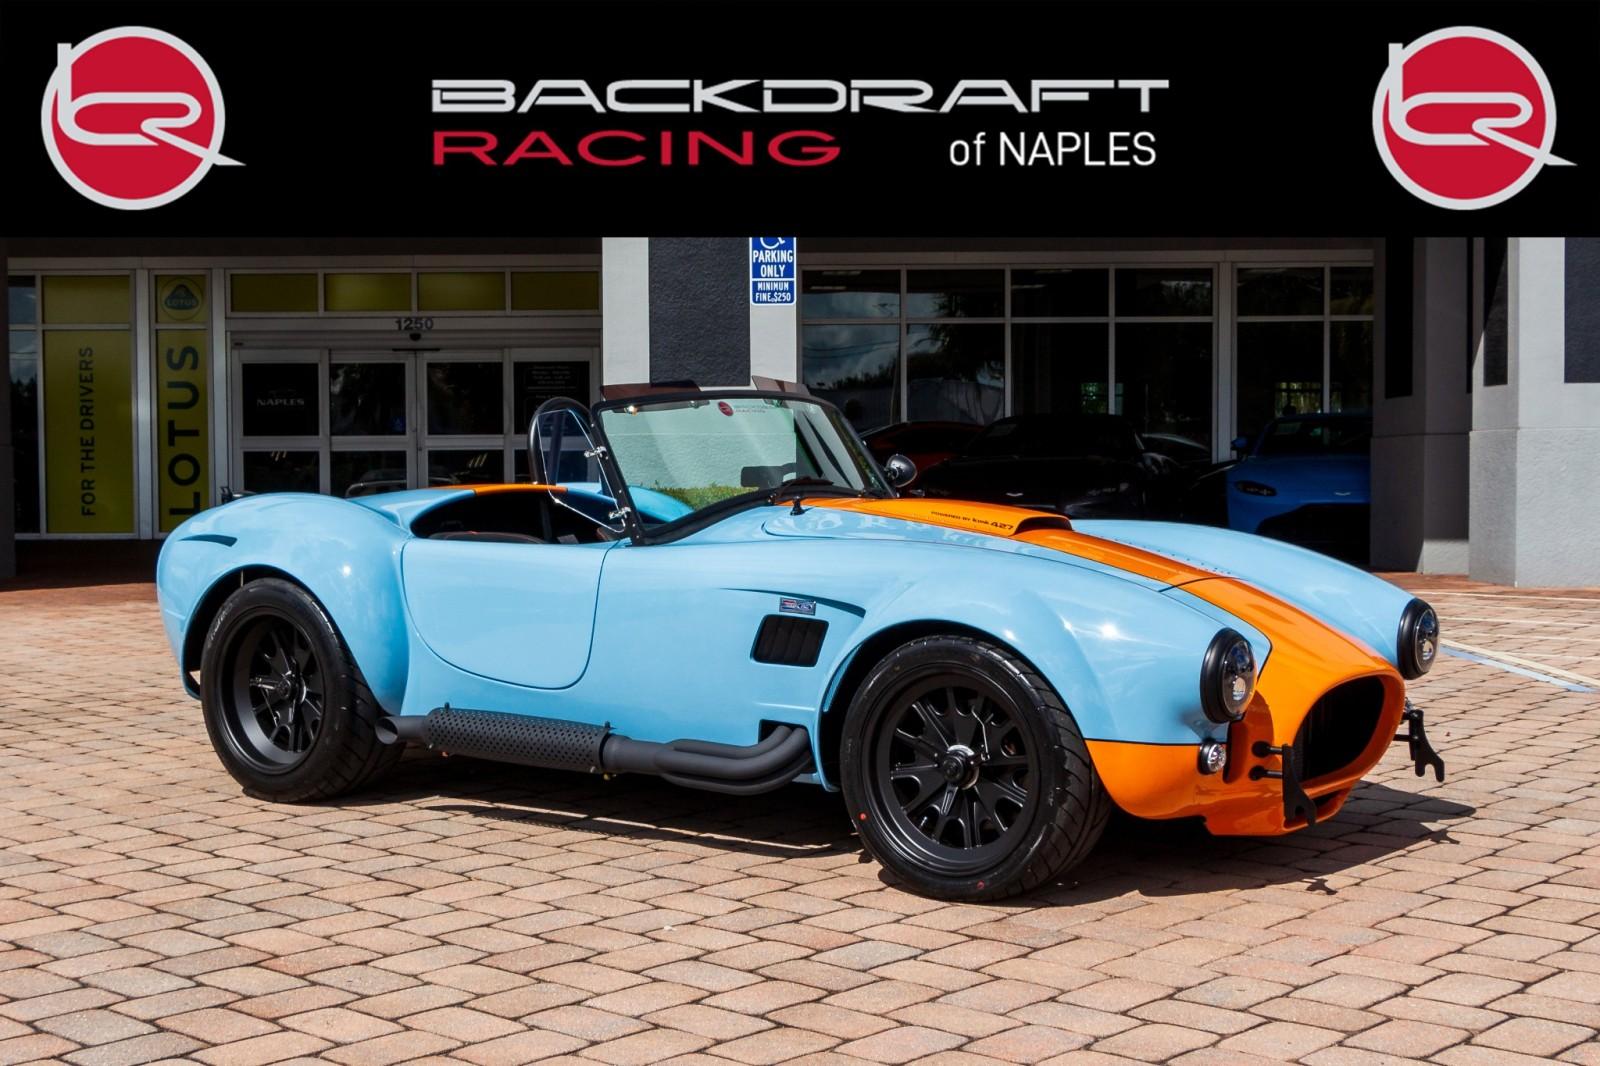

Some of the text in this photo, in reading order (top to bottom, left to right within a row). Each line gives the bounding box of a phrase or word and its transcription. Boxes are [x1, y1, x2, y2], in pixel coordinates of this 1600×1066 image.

[753, 250, 793, 263] PARKING
[761, 264, 785, 277] ONLY
[757, 281, 789, 292] MINIMUM
[395, 317, 434, 331] 1250
[257, 398, 304, 406] NAPLES
[79, 346, 96, 518] FOR THE DRIVERS
[167, 346, 200, 515] LOTUS
[991, 521, 1013, 529] 427
